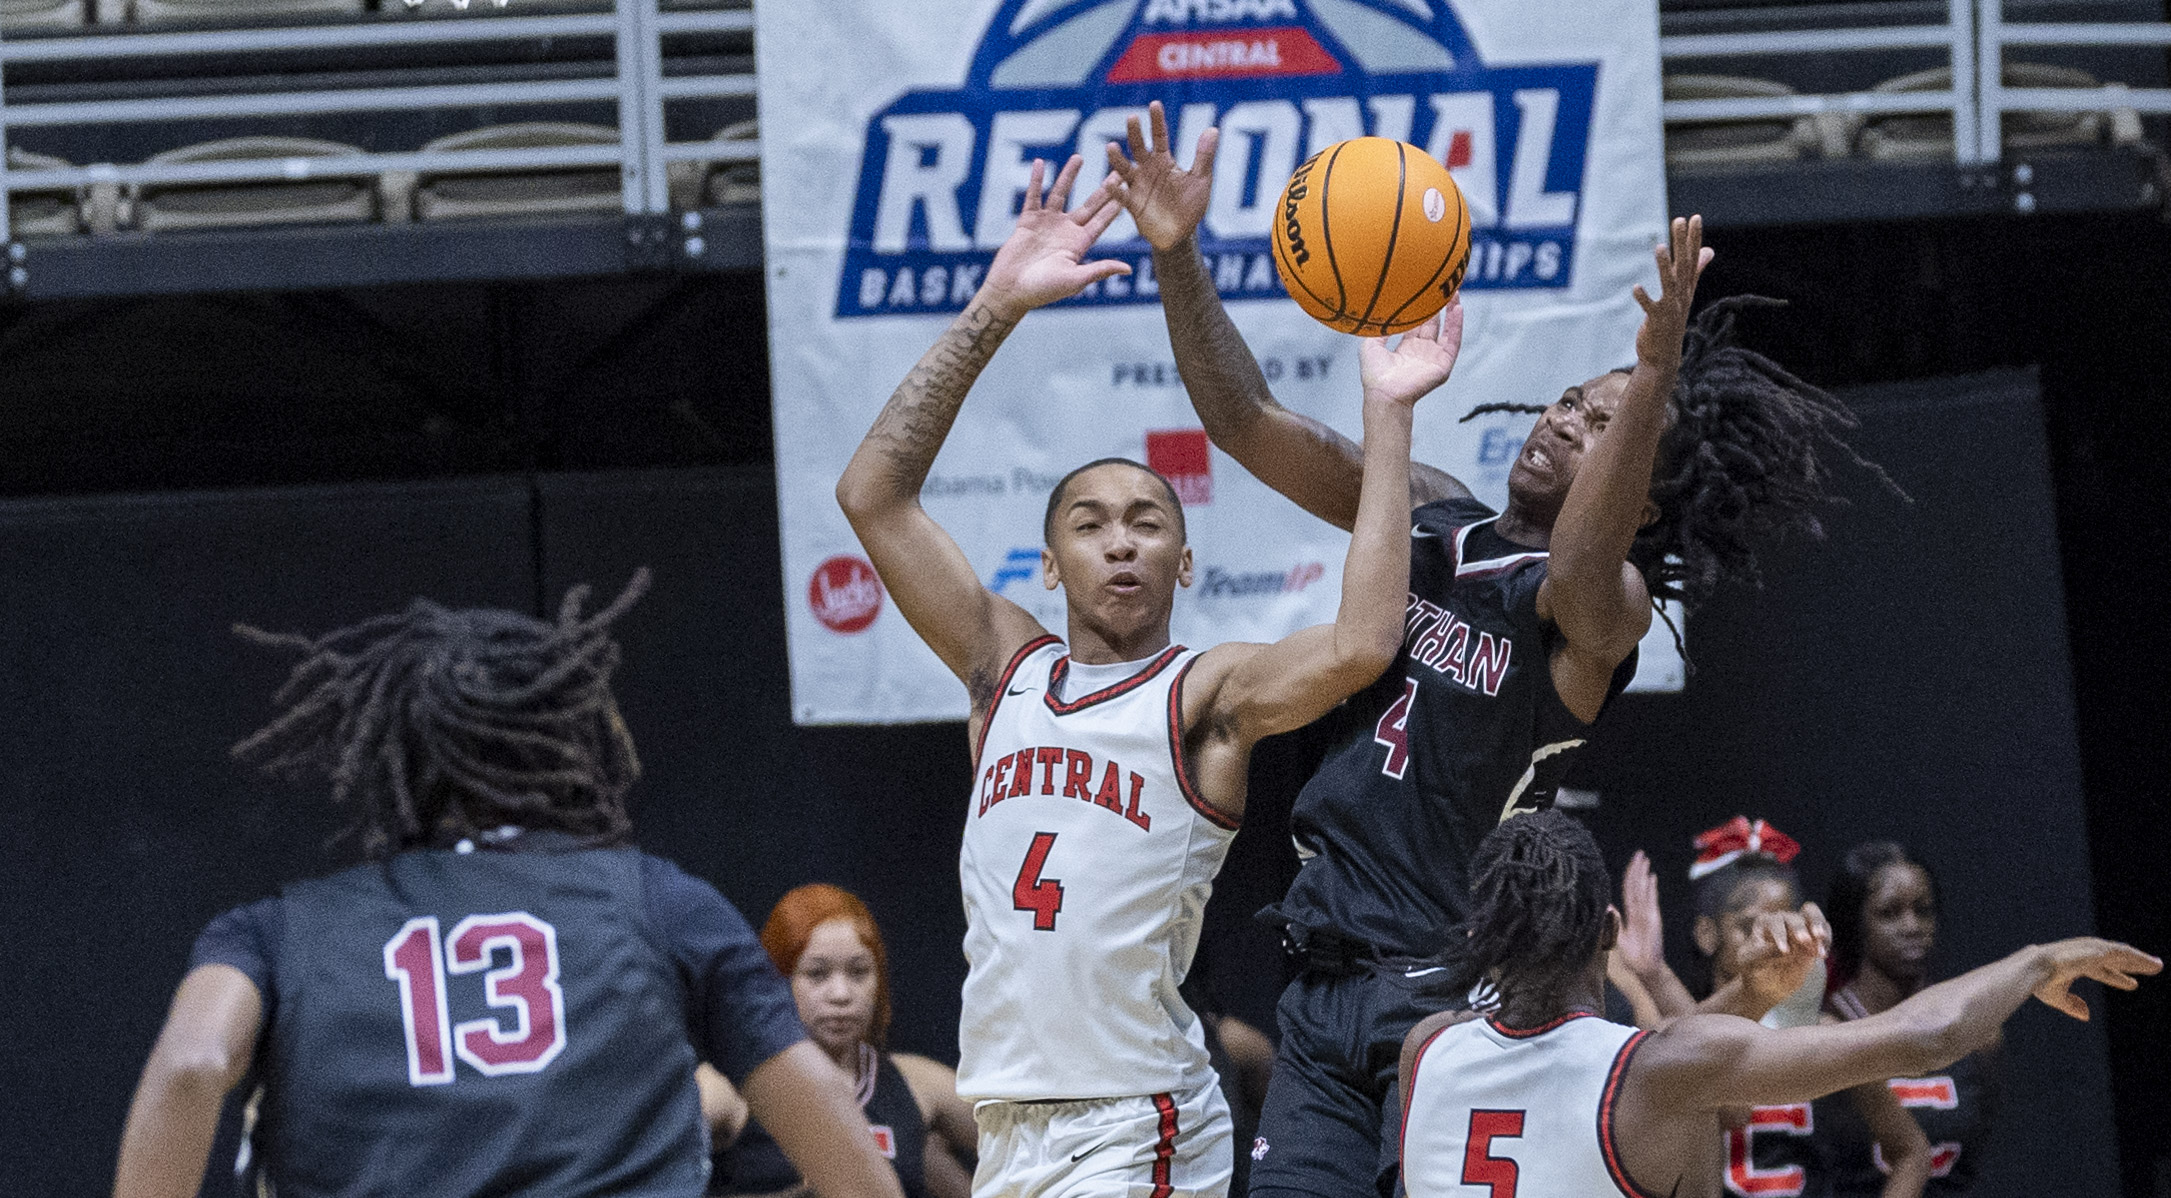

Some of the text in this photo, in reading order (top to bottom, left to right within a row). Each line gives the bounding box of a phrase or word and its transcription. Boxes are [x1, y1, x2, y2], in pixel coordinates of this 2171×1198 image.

[1157, 38, 1283, 72] CENTRAL
[1374, 676, 1419, 781] 4
[978, 746, 1151, 833] CENTRAL
[1012, 831, 1065, 932] 4
[384, 911, 567, 1086] 13
[1460, 1108, 1527, 1198] 5
